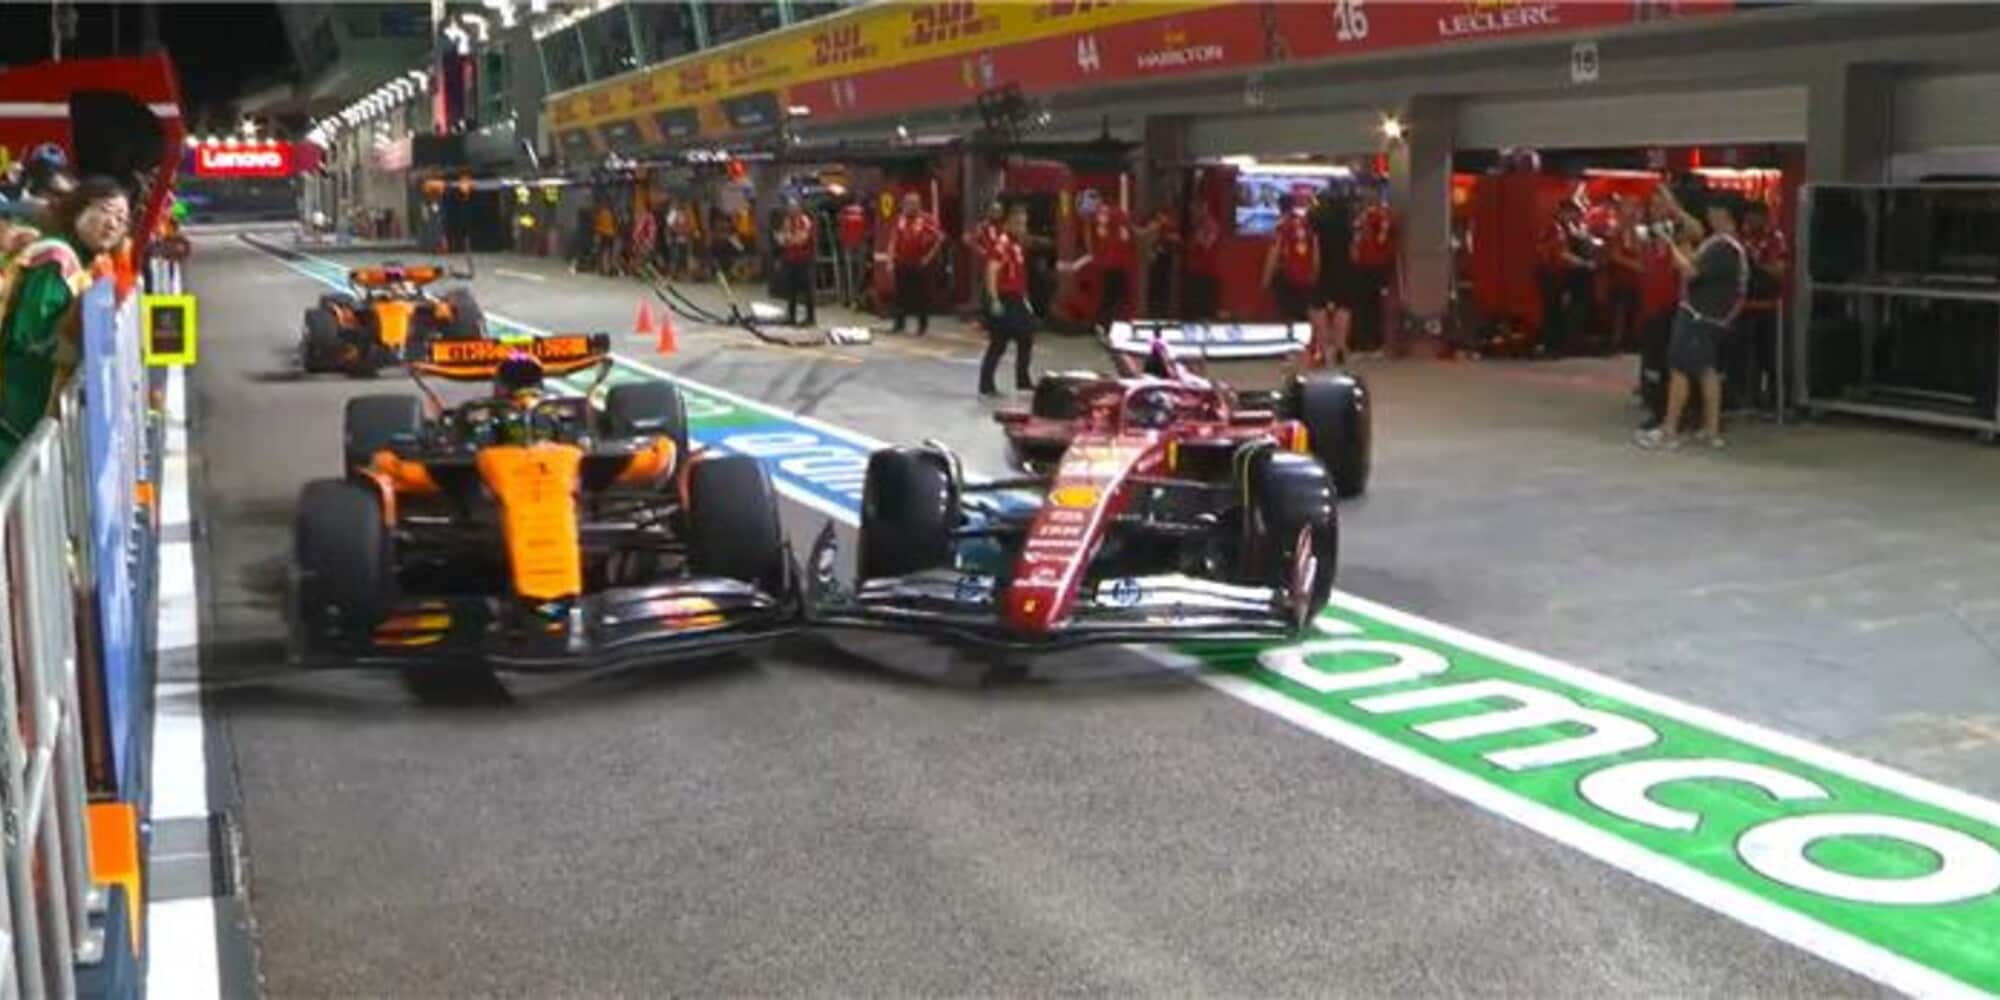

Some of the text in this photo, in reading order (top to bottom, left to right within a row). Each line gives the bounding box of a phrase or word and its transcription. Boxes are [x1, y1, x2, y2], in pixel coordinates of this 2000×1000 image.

[1334, 0, 1368, 41] 16
[1438, 6, 1560, 35] LECLERC
[1077, 35, 1099, 72] 44
[1137, 45, 1223, 68] HAMILTON
[202, 148, 282, 168] Lenovo
